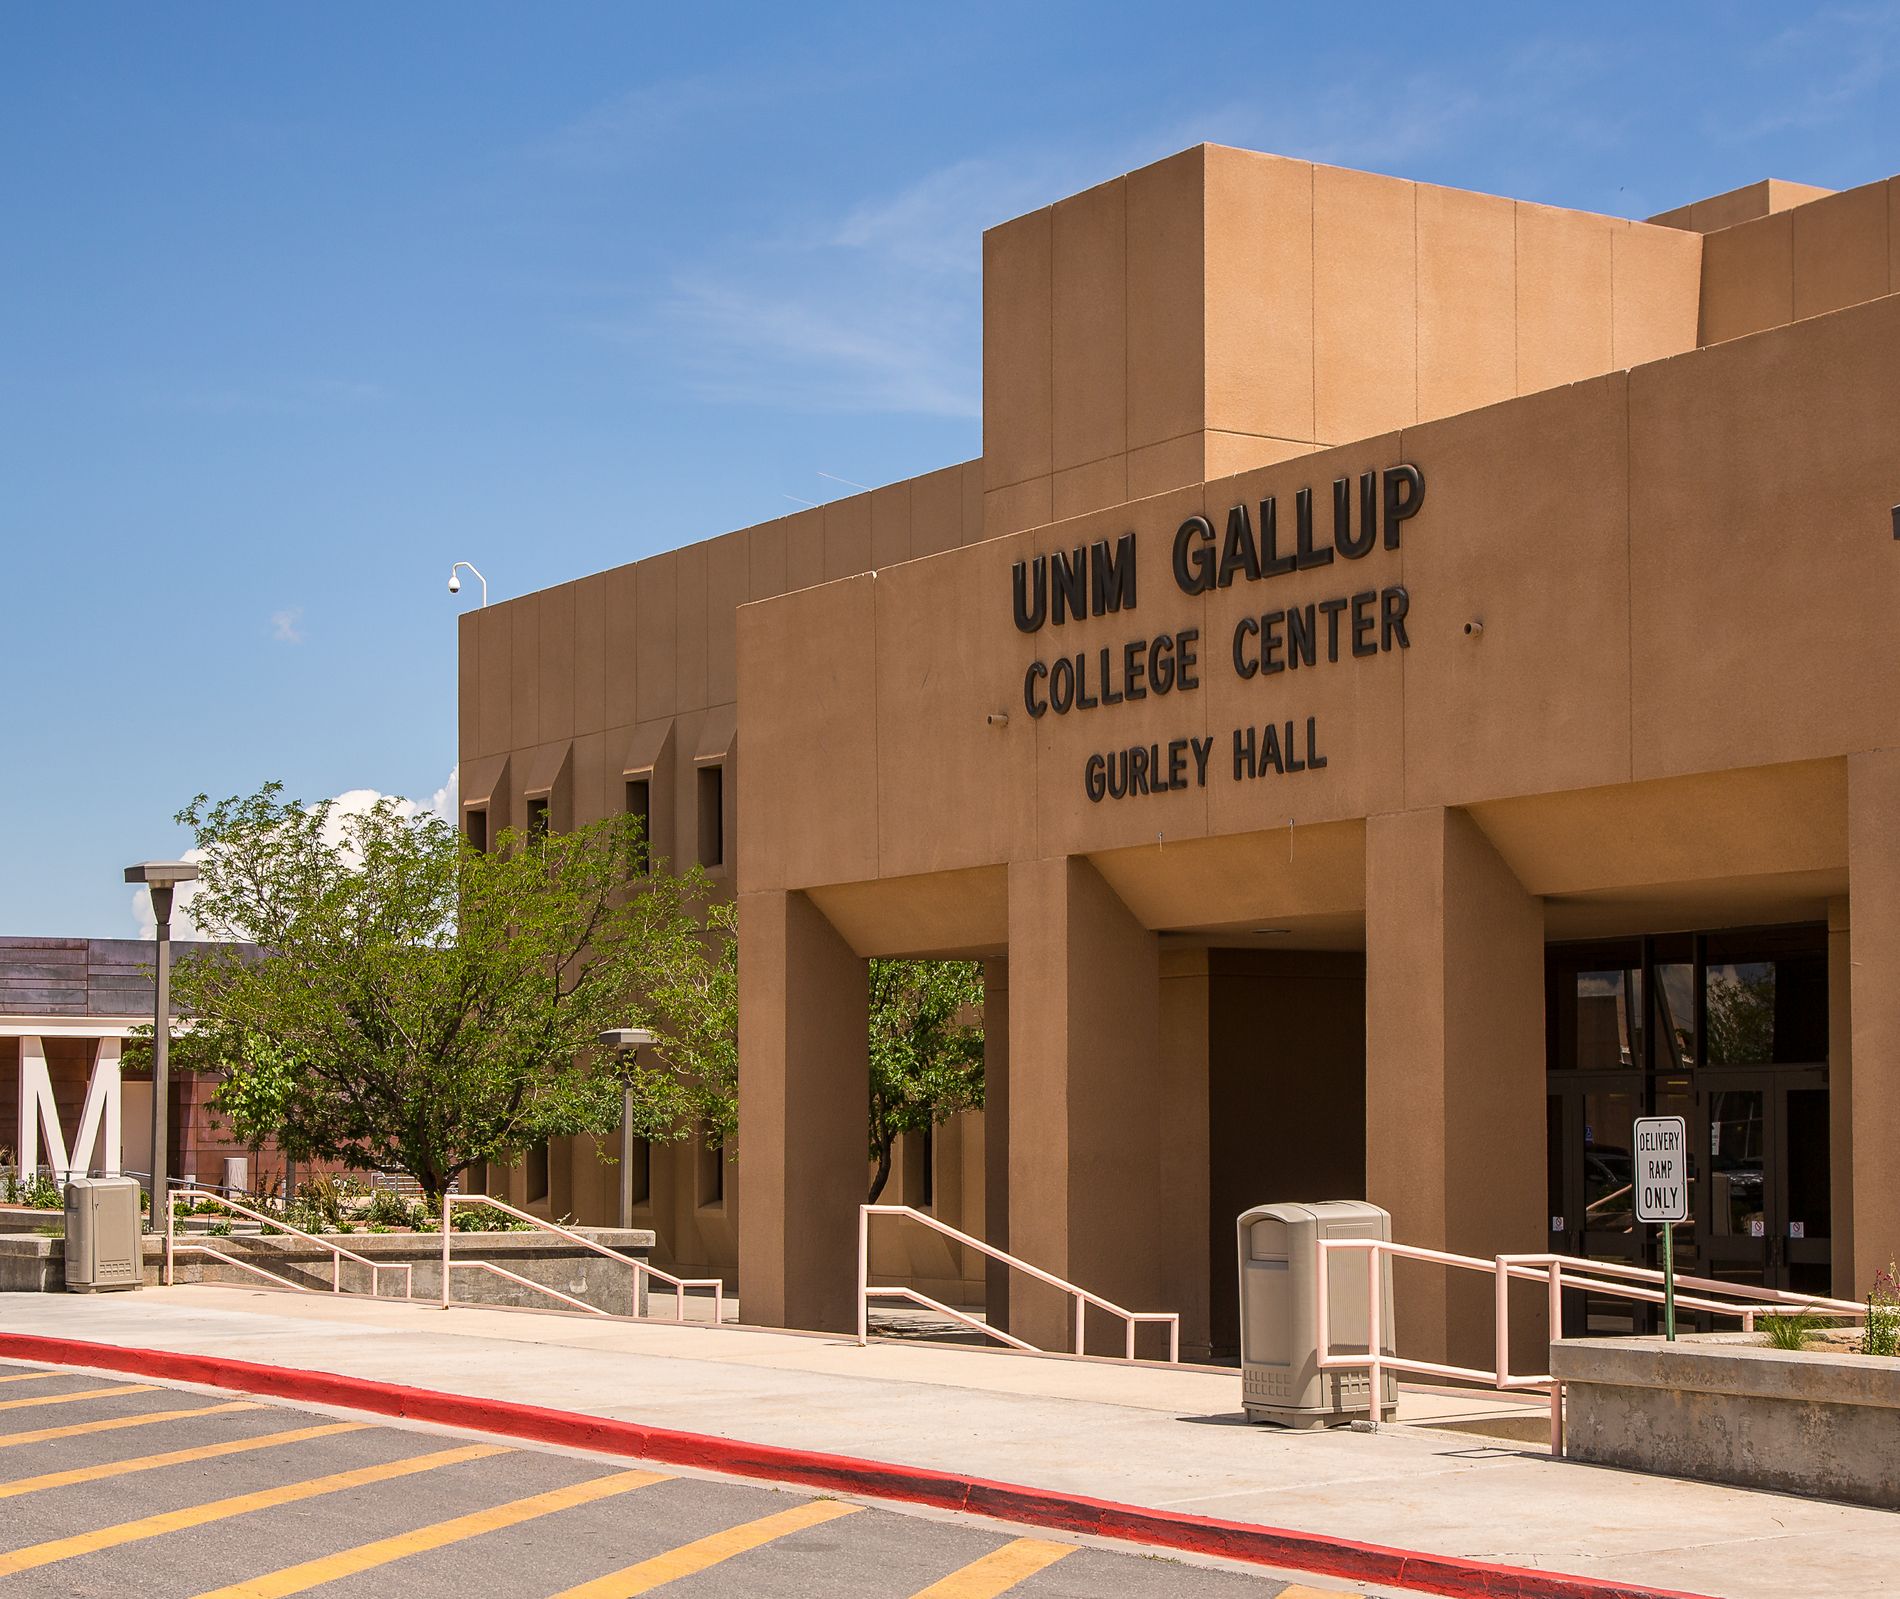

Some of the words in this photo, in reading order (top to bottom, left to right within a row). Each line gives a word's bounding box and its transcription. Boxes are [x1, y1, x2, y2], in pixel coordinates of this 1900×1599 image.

[1012, 533, 1136, 633] UNM
[1172, 463, 1425, 596] GALLUP
[1024, 629, 1199, 719] COLLEGE
[1233, 586, 1410, 680] CENTER
[1085, 736, 1214, 803] GURLEY
[1233, 716, 1327, 781] HALL
[1639, 1132, 1680, 1151] DELIVERY
[1649, 1160, 1672, 1179] RAMP
[1645, 1187, 1678, 1208] ONLY
